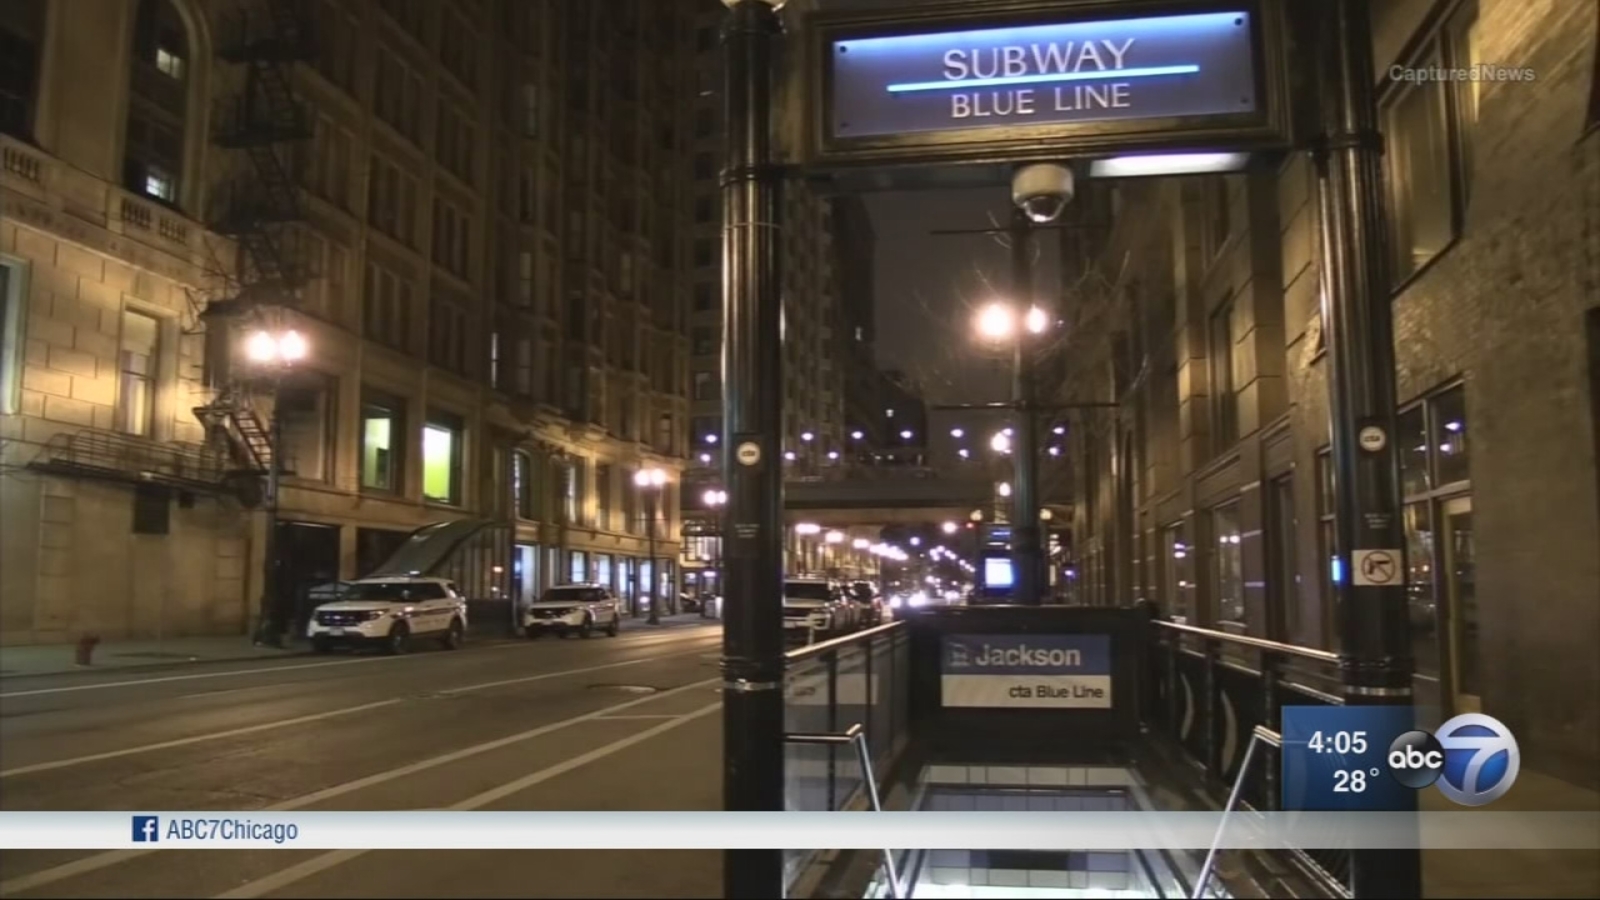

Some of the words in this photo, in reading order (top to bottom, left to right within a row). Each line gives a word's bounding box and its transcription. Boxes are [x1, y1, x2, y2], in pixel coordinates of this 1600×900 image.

[943, 38, 1135, 80] SUBWAY
[951, 89, 1035, 119] BLUE
[1054, 82, 1131, 111] LINE
[975, 643, 1081, 667] Jackson
[1008, 685, 1032, 698] cta
[1036, 685, 1069, 698] Blue
[1073, 685, 1104, 698] Line
